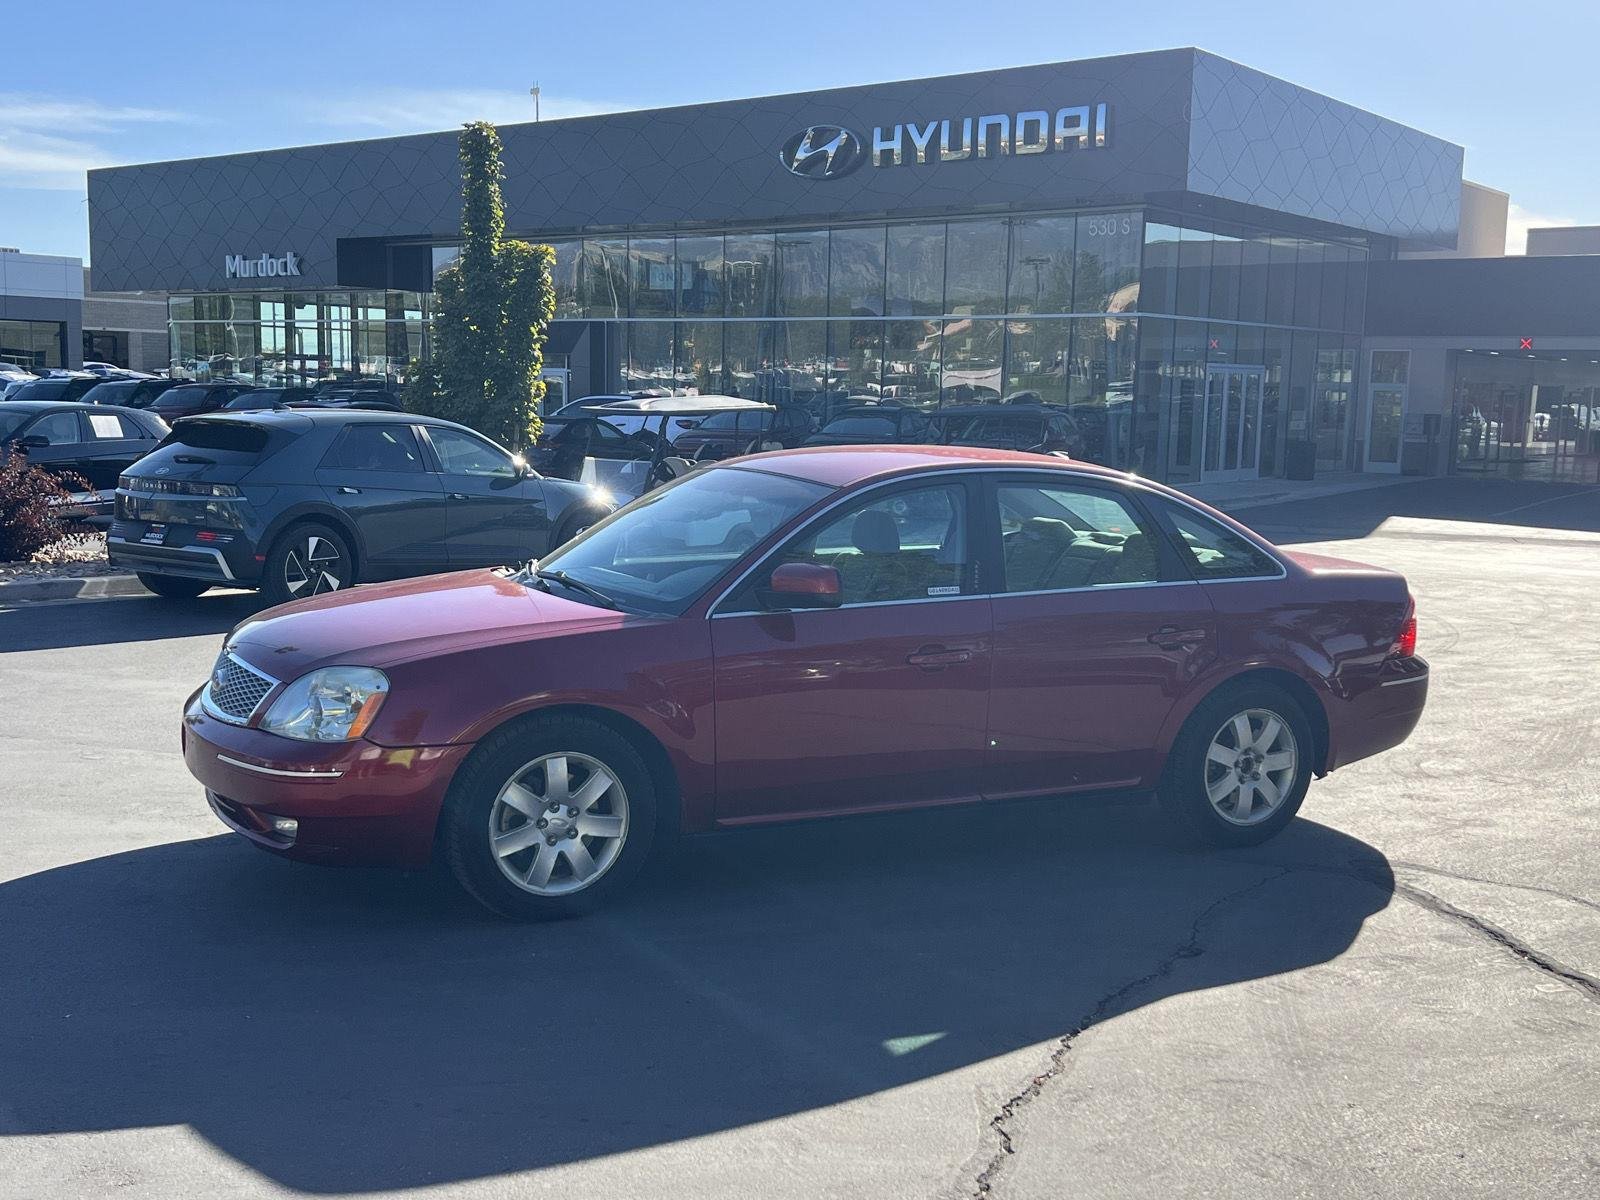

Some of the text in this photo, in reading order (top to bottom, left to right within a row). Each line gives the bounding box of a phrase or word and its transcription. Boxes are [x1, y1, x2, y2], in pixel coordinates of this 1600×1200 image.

[872, 102, 1108, 167] HYUNDAI
[1088, 217, 1130, 236] 530 S
[225, 251, 301, 278] Murdock
